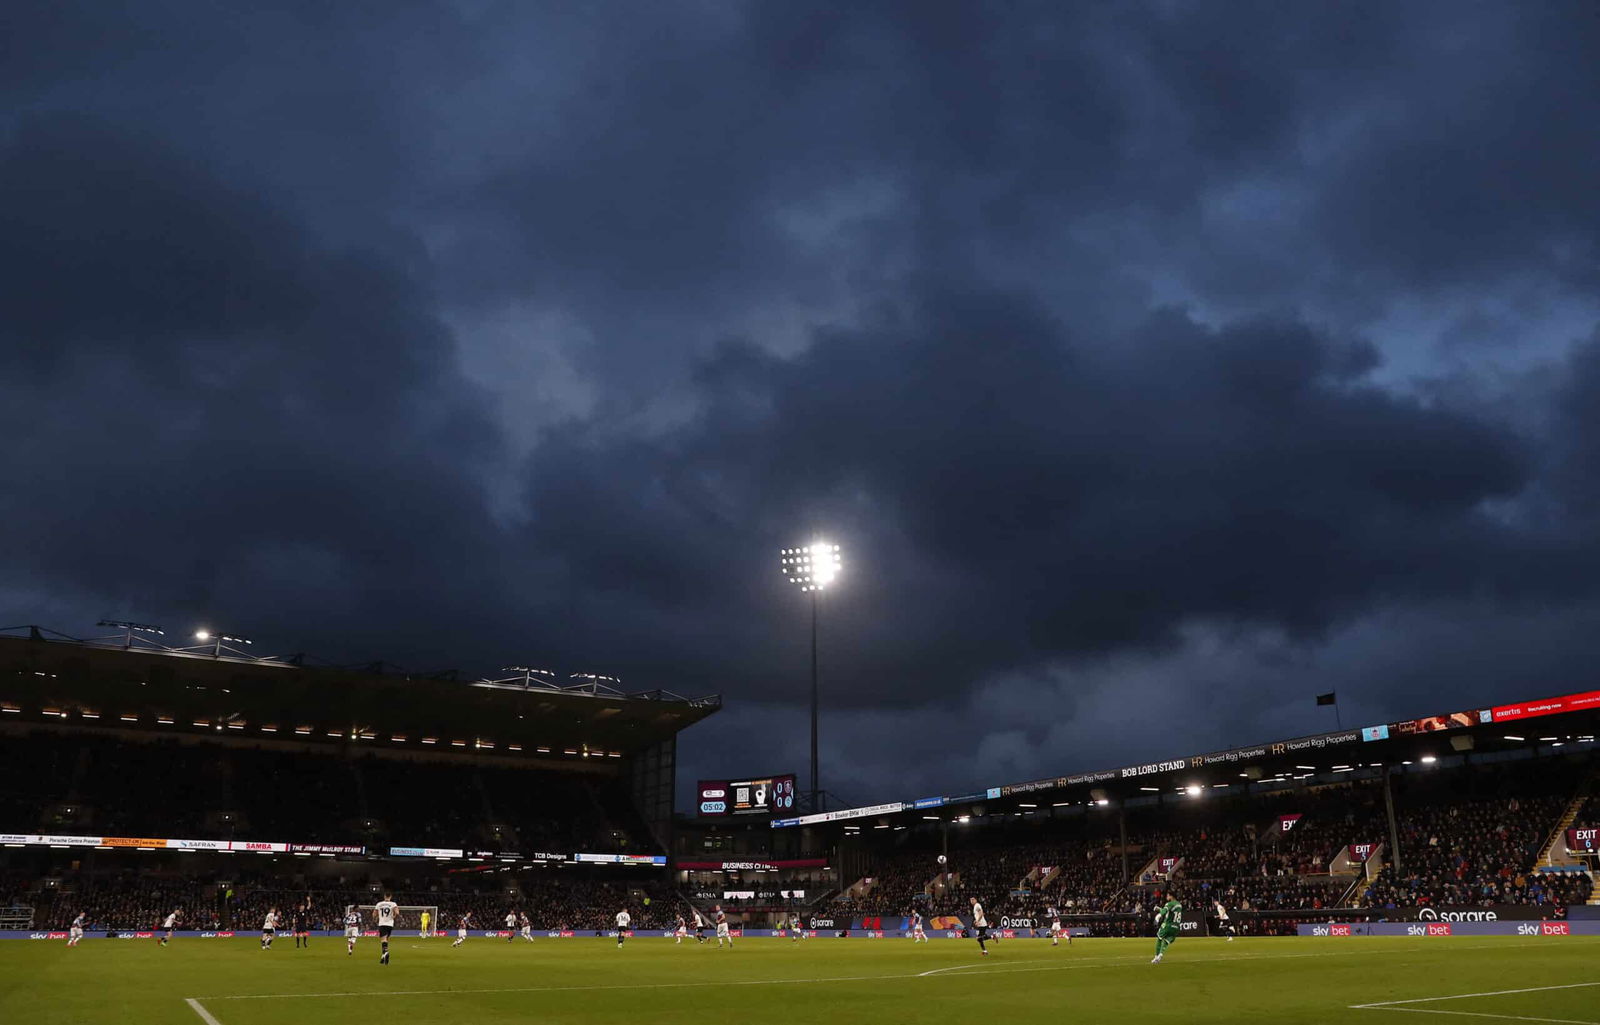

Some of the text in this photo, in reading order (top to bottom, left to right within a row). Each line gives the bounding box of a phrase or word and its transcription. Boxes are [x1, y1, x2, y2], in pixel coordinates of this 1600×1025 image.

[1496, 708, 1521, 718] exertis
[1272, 733, 1357, 755] HR Howard Rigg Properties
[1191, 748, 1265, 768] HR Howard Rigg Properties
[1122, 760, 1185, 778] BOB LORD STAND
[1058, 778, 1067, 788] HR
[1067, 775, 1084, 784] Howard
[1094, 772, 1115, 782] Properties
[776, 782, 783, 794] 0
[703, 803, 723, 811] 05:02
[776, 796, 783, 808] 0
[1282, 819, 1297, 831] EX
[1576, 829, 1598, 840] EXIT
[245, 842, 272, 850] SAMBA
[1585, 839, 1592, 848] 6
[1355, 845, 1371, 854] EXIT
[1162, 858, 1174, 866] EXIT
[380, 907, 390, 918] 19
[1173, 911, 1182, 923] 18
[1440, 909, 1498, 922] sorare
[816, 919, 834, 927] sorare
[1011, 918, 1038, 928] sora
[1179, 921, 1198, 931] rare
[1003, 930, 1014, 938] bet
[1312, 925, 1349, 936] sky bet
[1407, 924, 1449, 937] sky bet
[1517, 922, 1567, 936] sky bet
